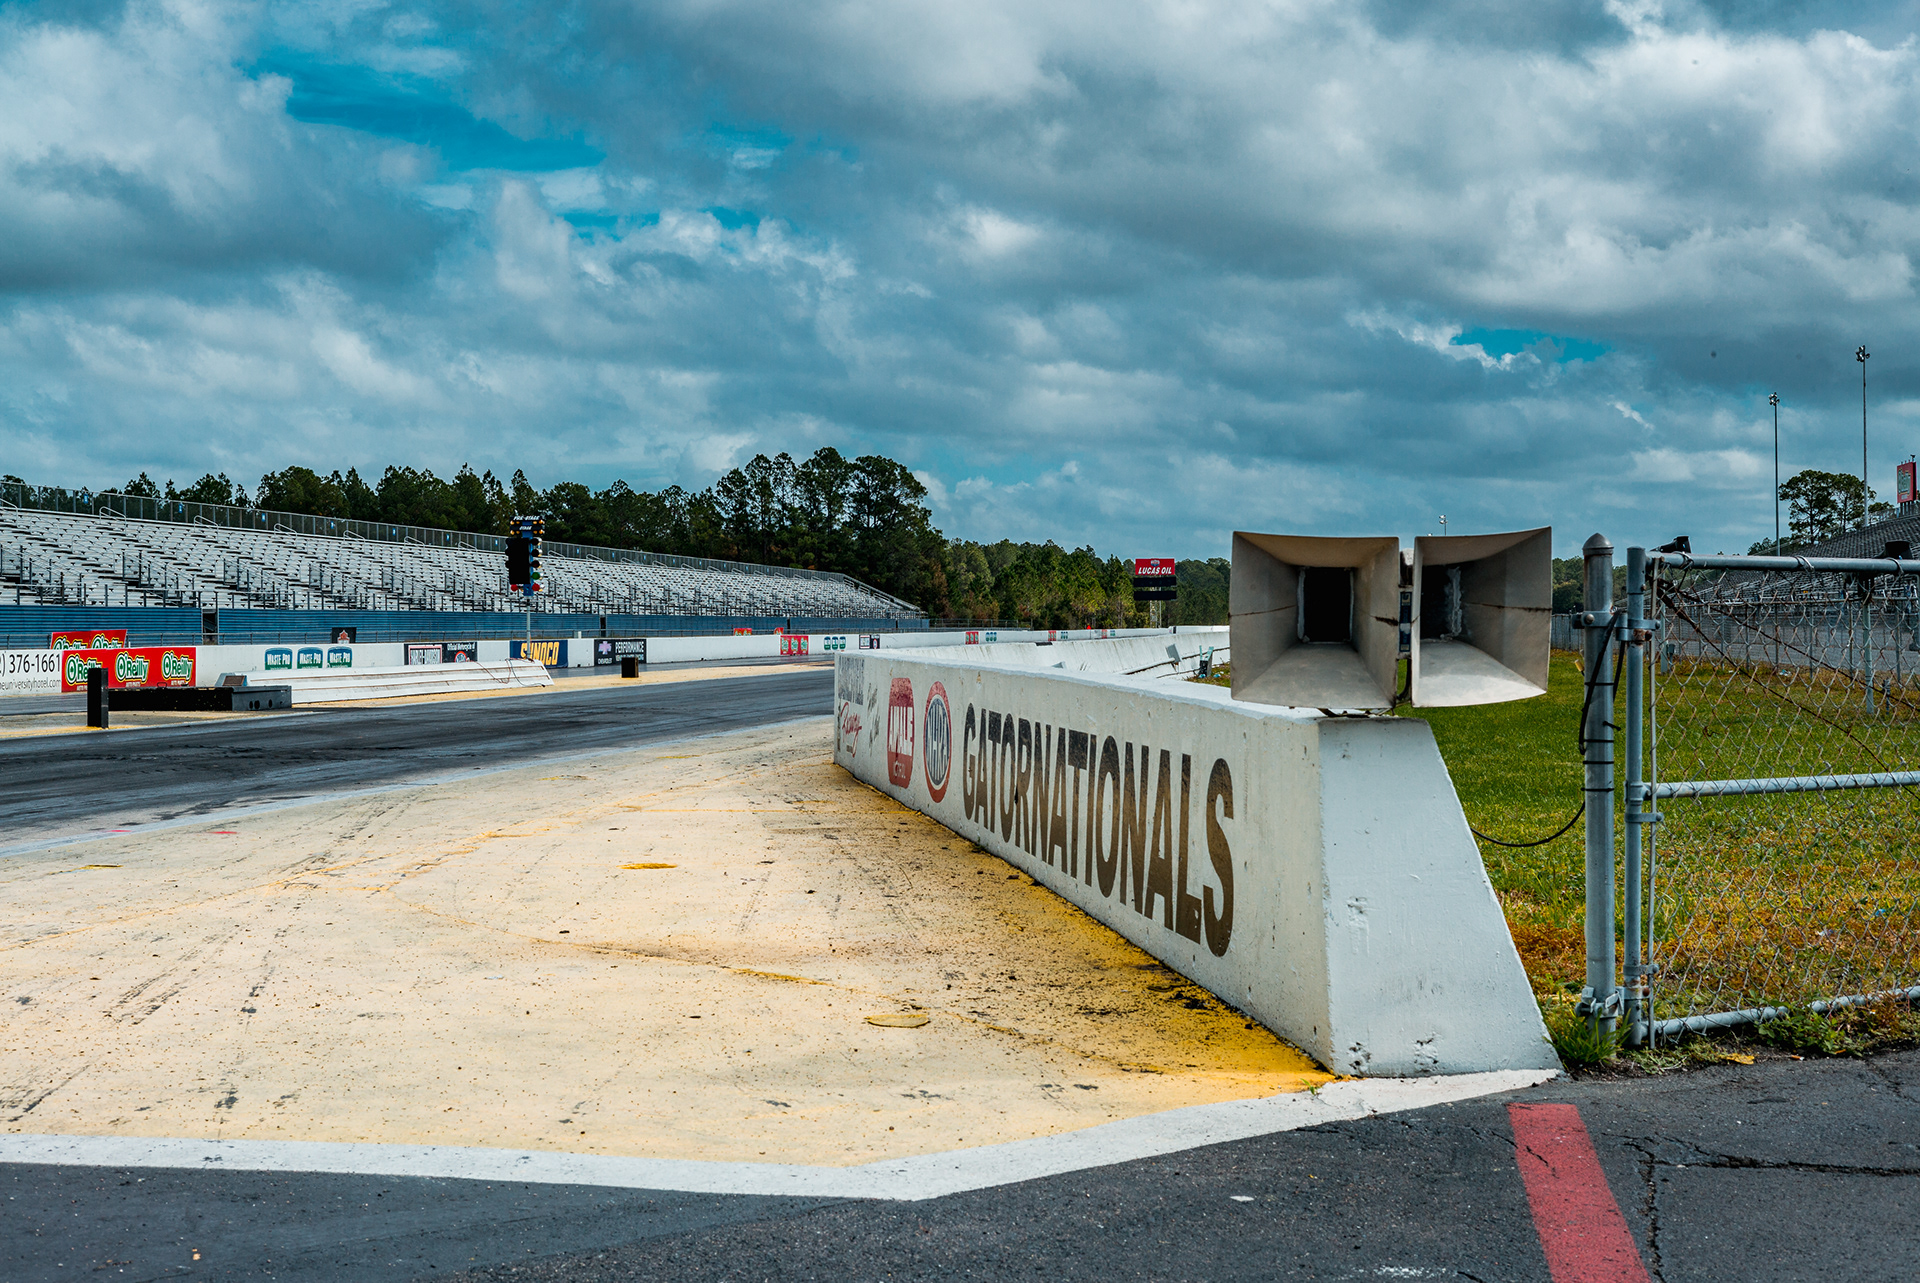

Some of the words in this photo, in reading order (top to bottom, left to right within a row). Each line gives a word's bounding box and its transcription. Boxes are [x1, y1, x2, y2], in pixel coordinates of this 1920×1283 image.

[615, 641, 644, 653] PERFORMANCE
[9, 653, 60, 673] 376-1661
[116, 652, 149, 682] O'Reilly
[162, 651, 193, 681] O'Reilly
[927, 704, 948, 781] NHRA
[963, 703, 1234, 957] GATORNATIONALS
